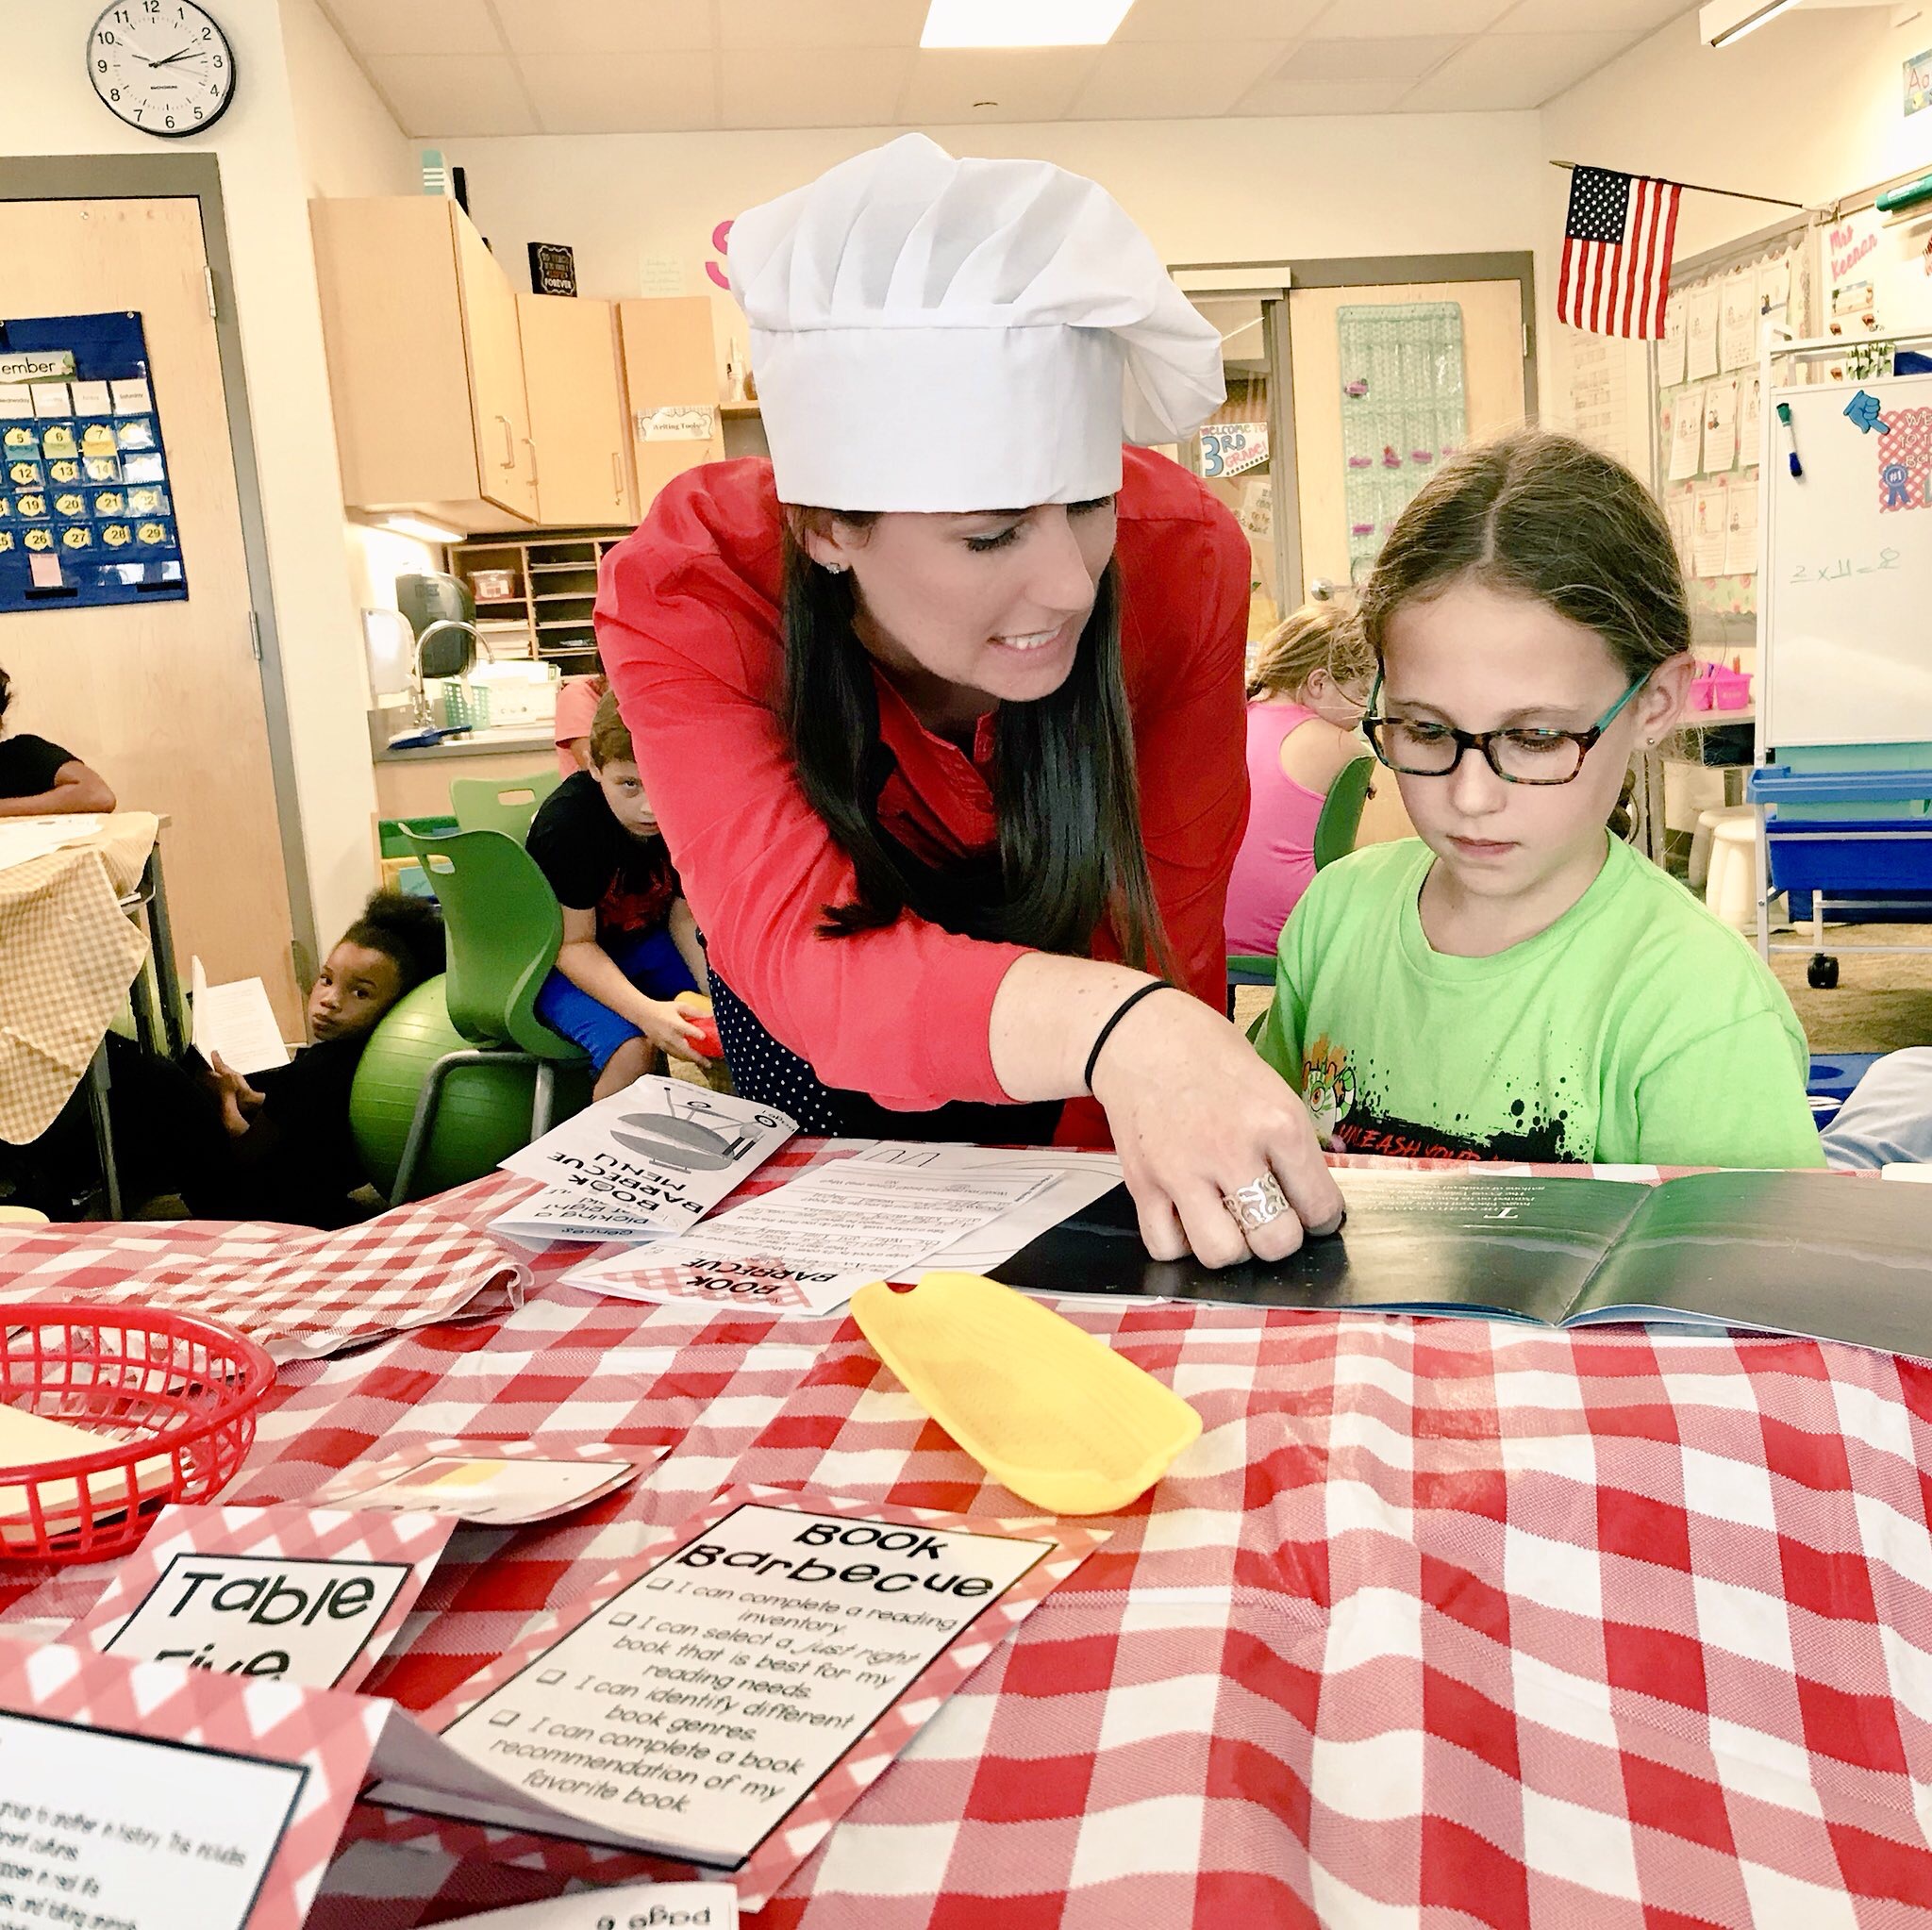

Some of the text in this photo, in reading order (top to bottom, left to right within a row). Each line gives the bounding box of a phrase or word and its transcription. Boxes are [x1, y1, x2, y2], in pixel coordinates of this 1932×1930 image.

[143, 1, 159, 13] 12
[177, 7, 186, 20] 1
[114, 9, 129, 24] 11
[98, 31, 115, 45] 10
[201, 27, 211, 41] 2
[97, 59, 108, 73] 9
[213, 55, 223, 69] 3
[110, 88, 121, 102] 8
[209, 84, 220, 97] 4
[133, 108, 143, 122] 7
[165, 115, 175, 129] 6
[193, 107, 203, 120] 5
[17, 430, 104, 443] 5 6 7
[19, 468, 32, 478] 12
[59, 466, 74, 477] 13
[1889, 470, 1903, 482] #1
[25, 500, 40, 511] 19
[64, 500, 79, 509] 20
[105, 498, 119, 507] 21
[32, 534, 47, 545] 26
[72, 533, 87, 543] 27
[111, 530, 126, 541] 28
[146, 528, 161, 538] 29
[1338, 1123, 1422, 1157] UNLEASH
[592, 1153, 688, 1191] MENU
[547, 1151, 705, 1214] BARBECUE
[566, 1173, 661, 1211] BOOK
[682, 1257, 839, 1283] BARBECUE
[686, 1275, 782, 1295] BOOK
[676, 1544, 994, 1598] Barbecue
[168, 1572, 375, 1626] Table
[674, 1581, 959, 1634] I can complete a reading
[637, 1615, 923, 1666] I can select a just right
[612, 1635, 896, 1690] book that is best for my
[641, 1664, 736, 1691] reading
[574, 1675, 855, 1730] I can identify different
[605, 1704, 668, 1727] book
[527, 1717, 806, 1775] I can complete a book
[489, 1738, 785, 1804] recommendation of my
[522, 1768, 619, 1800] favorite
